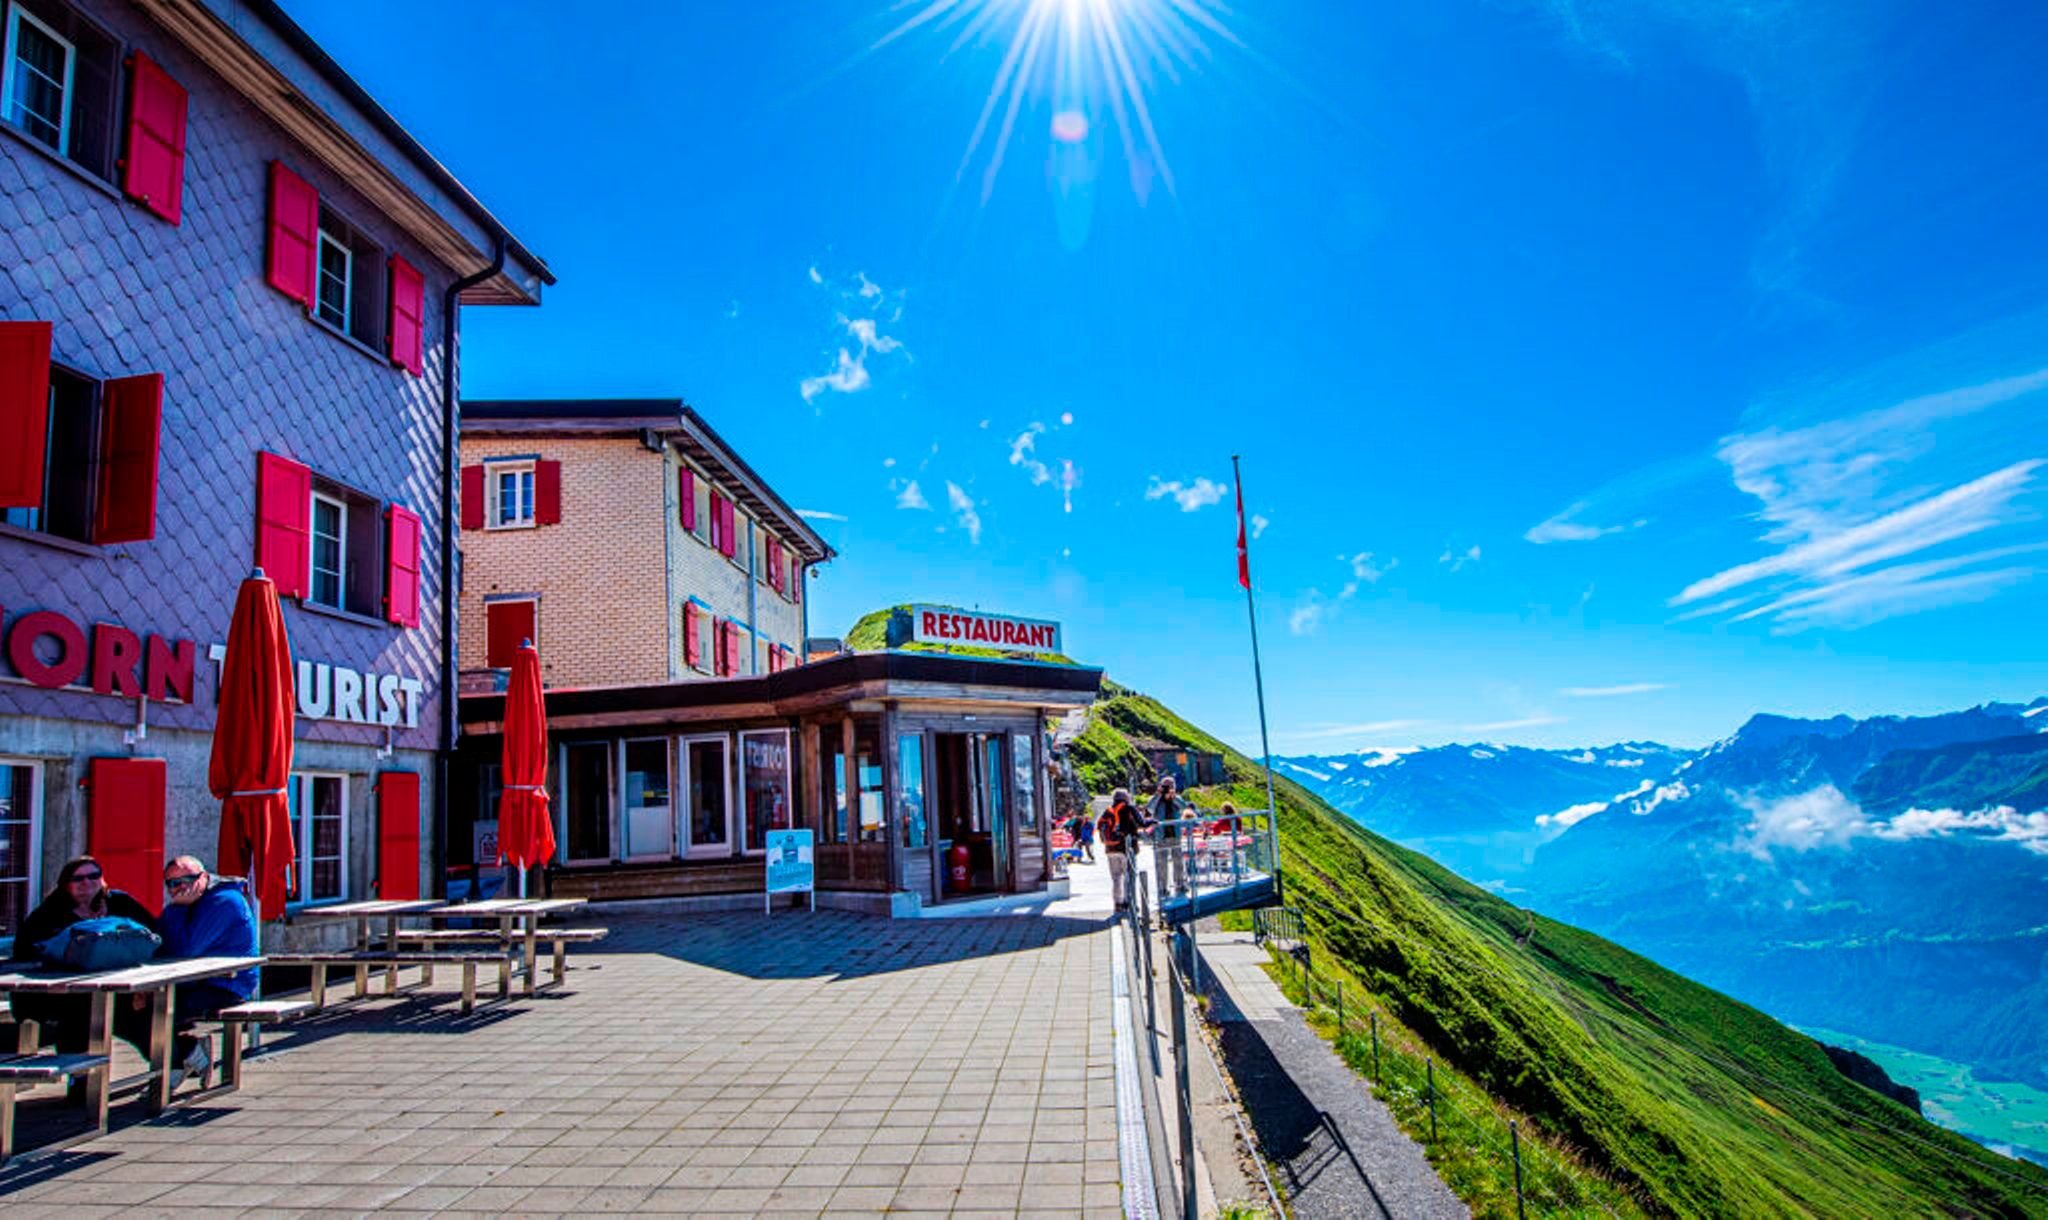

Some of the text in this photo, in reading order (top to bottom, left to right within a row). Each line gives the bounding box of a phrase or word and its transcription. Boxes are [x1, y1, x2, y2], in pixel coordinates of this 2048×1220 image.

[0, 605, 422, 729] ORN URIST
[922, 611, 1054, 648] RESTAURANT
